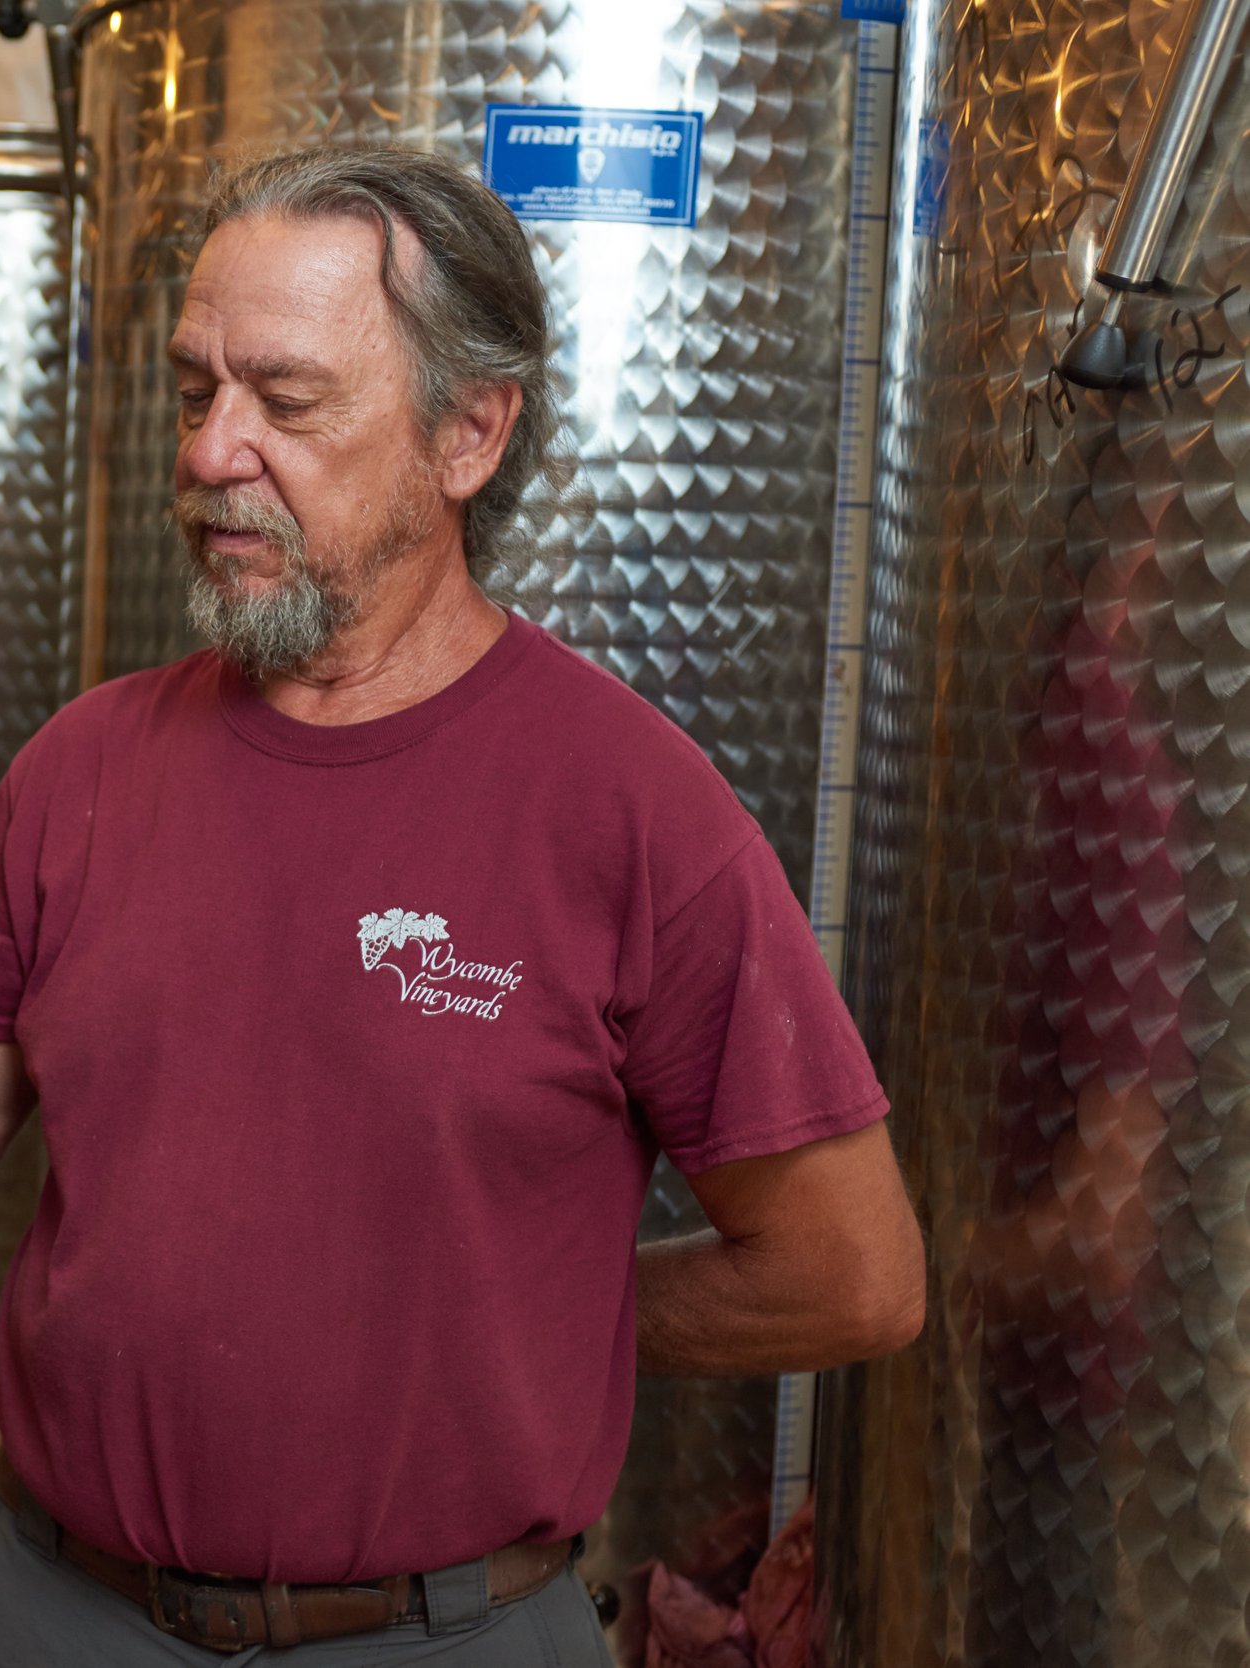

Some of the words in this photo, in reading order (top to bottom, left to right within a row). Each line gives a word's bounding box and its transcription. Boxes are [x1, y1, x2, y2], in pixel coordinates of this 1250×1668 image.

[507, 123, 682, 150] marchisio
[376, 962, 507, 1020] Vineyards
[409, 937, 523, 991] Wycombe
